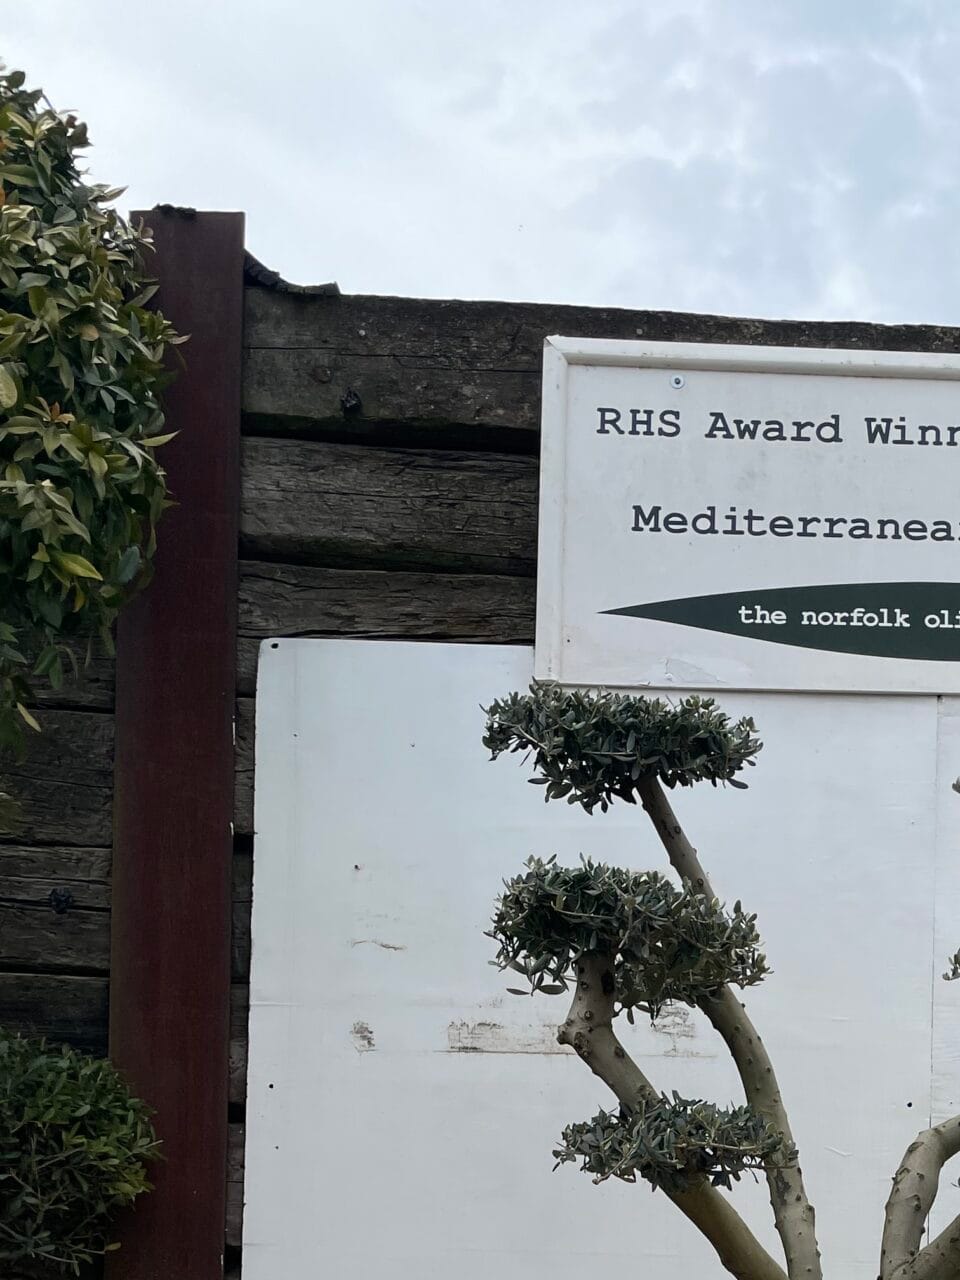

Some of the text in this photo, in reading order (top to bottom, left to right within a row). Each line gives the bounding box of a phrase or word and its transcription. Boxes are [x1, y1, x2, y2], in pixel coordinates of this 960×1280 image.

[597, 408, 681, 438] RHS
[705, 412, 843, 443] Award
[738, 605, 787, 625] the
[802, 608, 910, 628] norfolk
